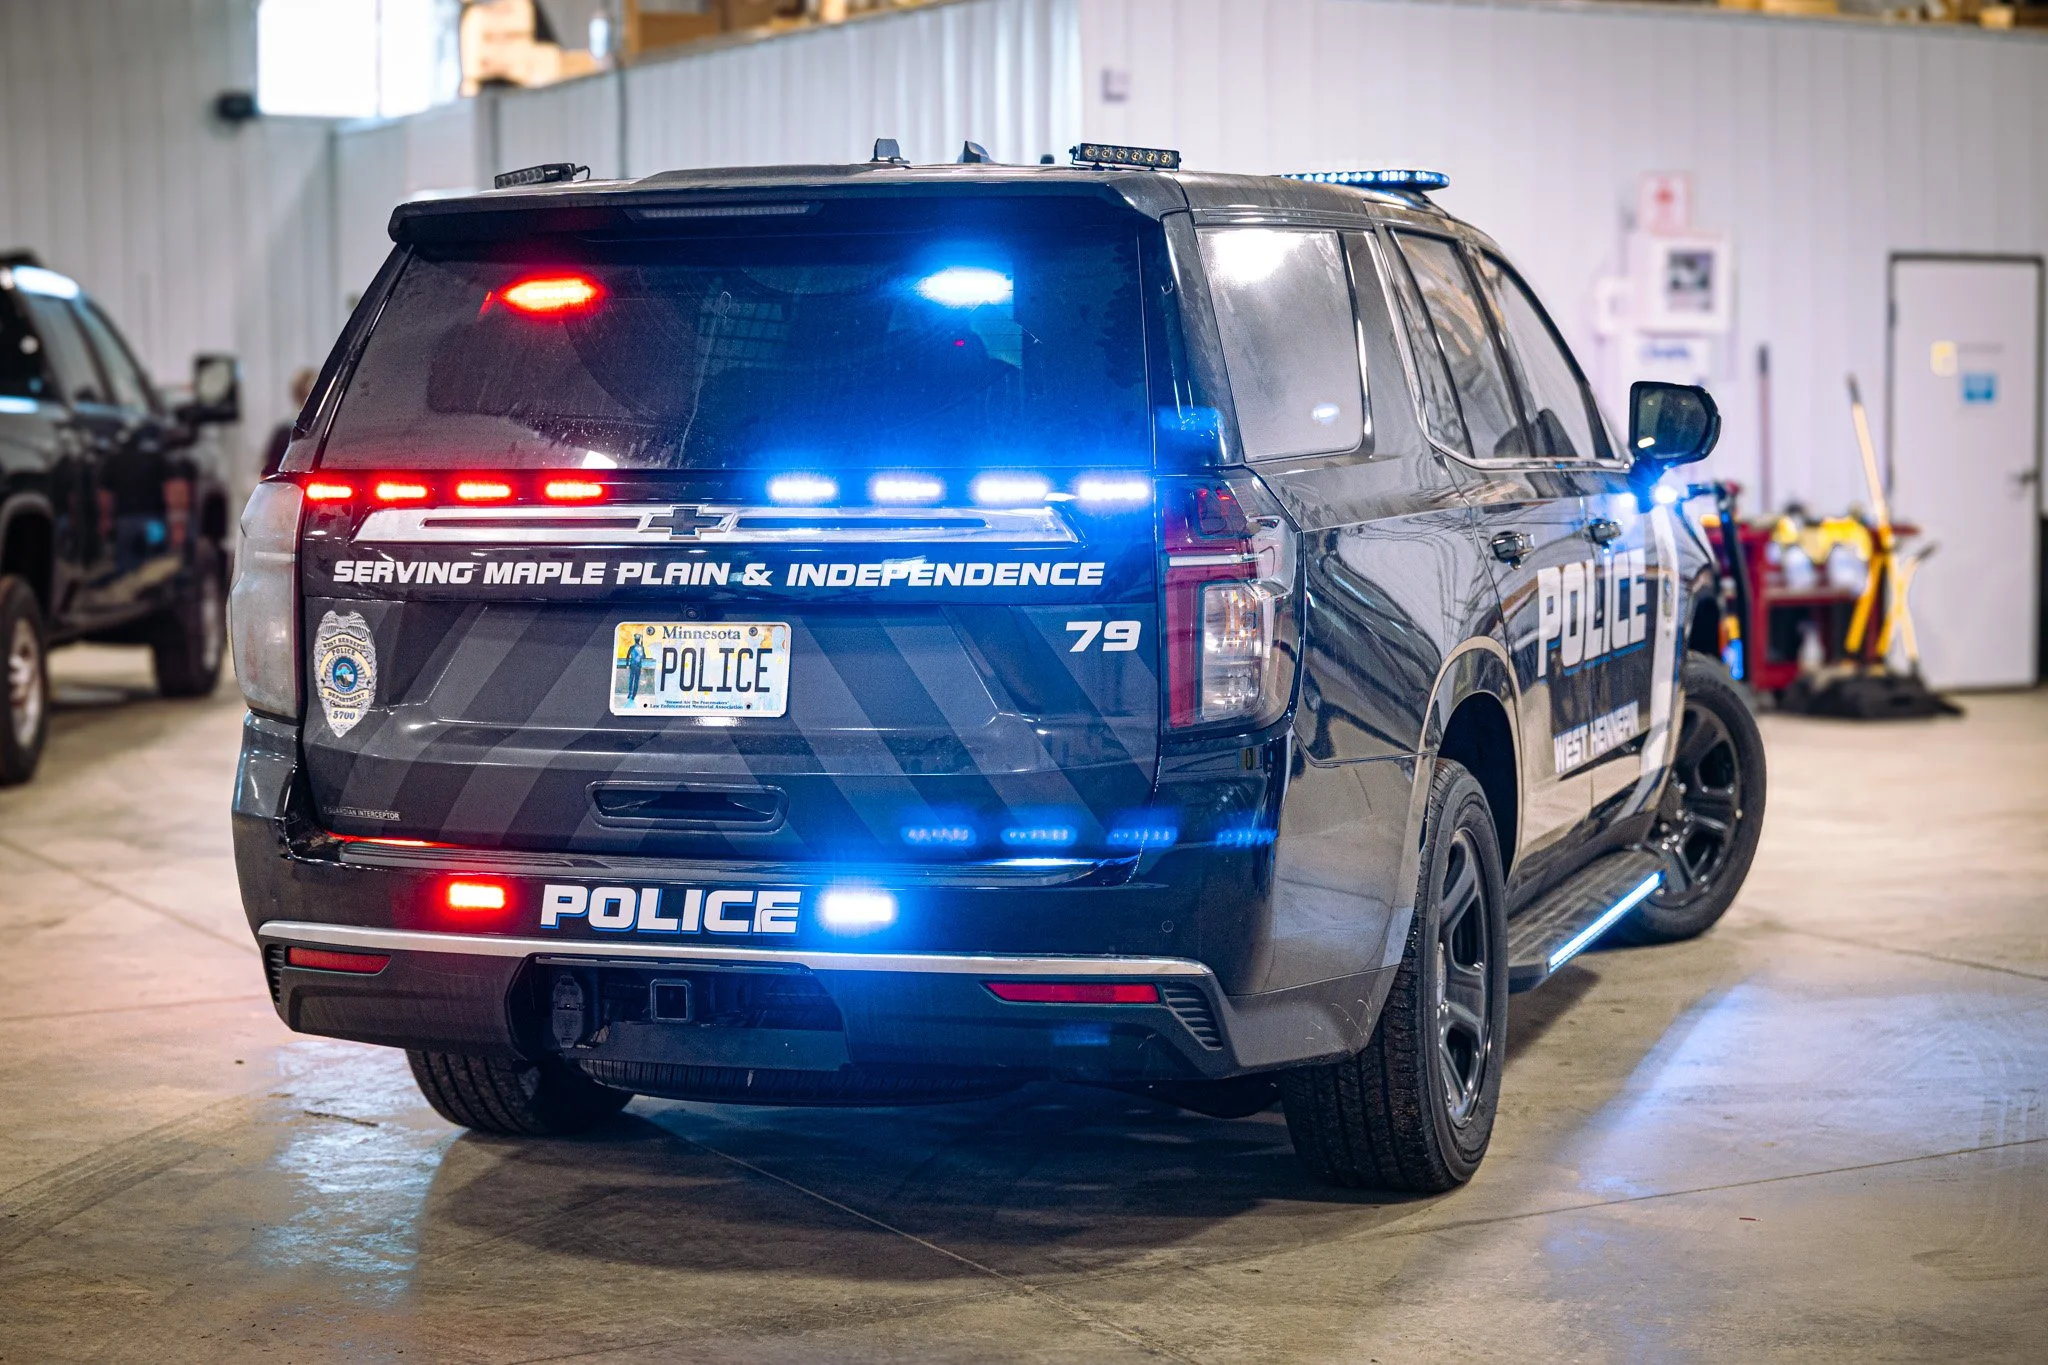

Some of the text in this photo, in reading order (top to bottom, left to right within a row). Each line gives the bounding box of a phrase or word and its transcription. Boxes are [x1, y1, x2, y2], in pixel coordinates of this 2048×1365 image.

[333, 560, 1106, 587] SERVING MAPLE PLAIN & INDEPENDENCE
[1537, 547, 1647, 677] POLICE
[662, 626, 742, 640] Minnesota
[1065, 620, 1142, 652] 79
[322, 639, 337, 649] WEST
[331, 647, 356, 657] POLICE
[660, 647, 773, 693] POLICE
[328, 691, 365, 703] DEPARTMENT
[332, 710, 356, 720] 5700
[1553, 723, 1589, 774] WEST
[358, 810, 400, 820] INTERCEPTOR
[540, 884, 802, 934] POLICE
